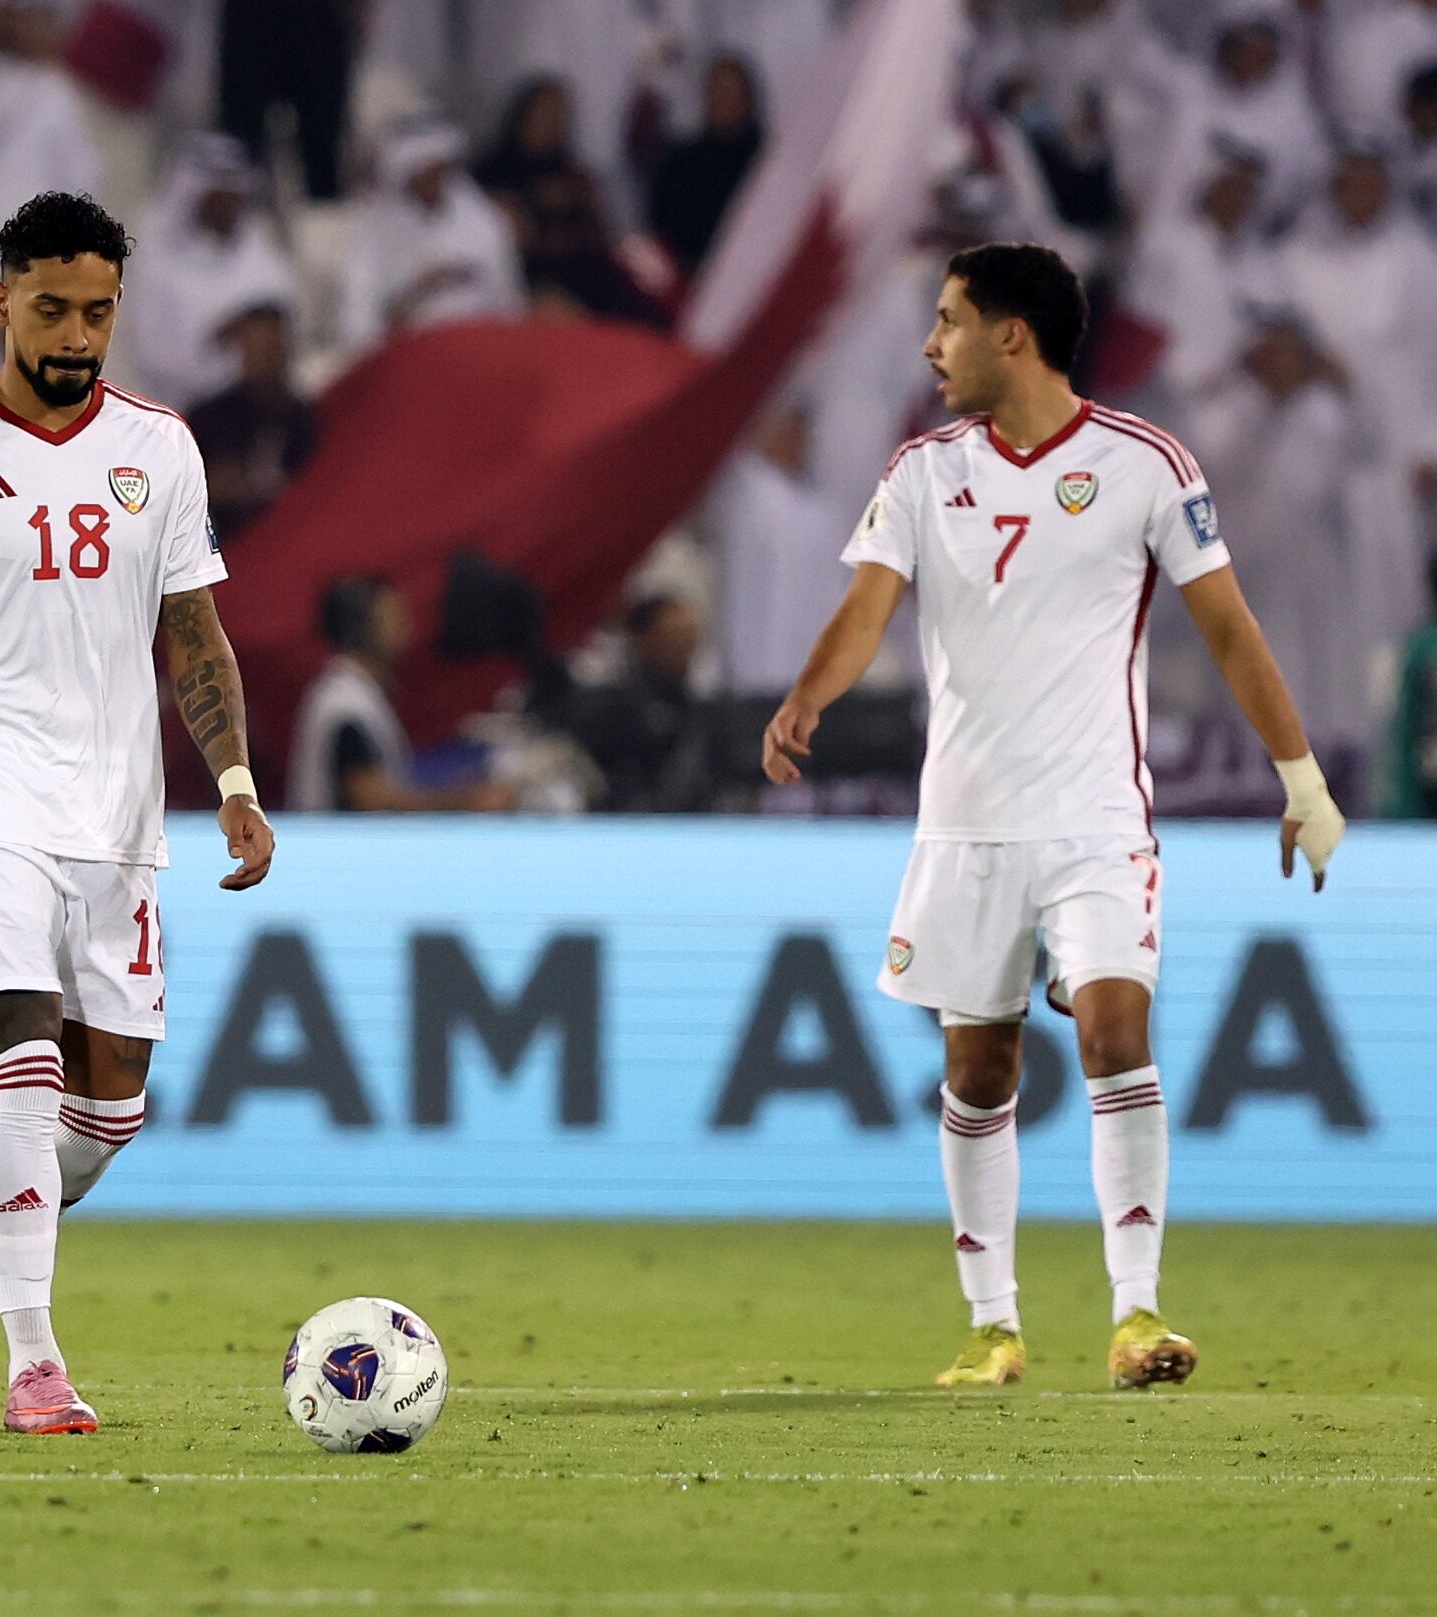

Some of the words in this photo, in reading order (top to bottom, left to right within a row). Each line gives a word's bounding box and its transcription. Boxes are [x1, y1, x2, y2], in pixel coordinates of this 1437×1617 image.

[119, 479, 139, 487] UAE
[27, 503, 110, 580] 18
[994, 515, 1030, 583] 7
[128, 899, 164, 976] 1
[708, 930, 1380, 1134] AA
[393, 1370, 439, 1413] molten
